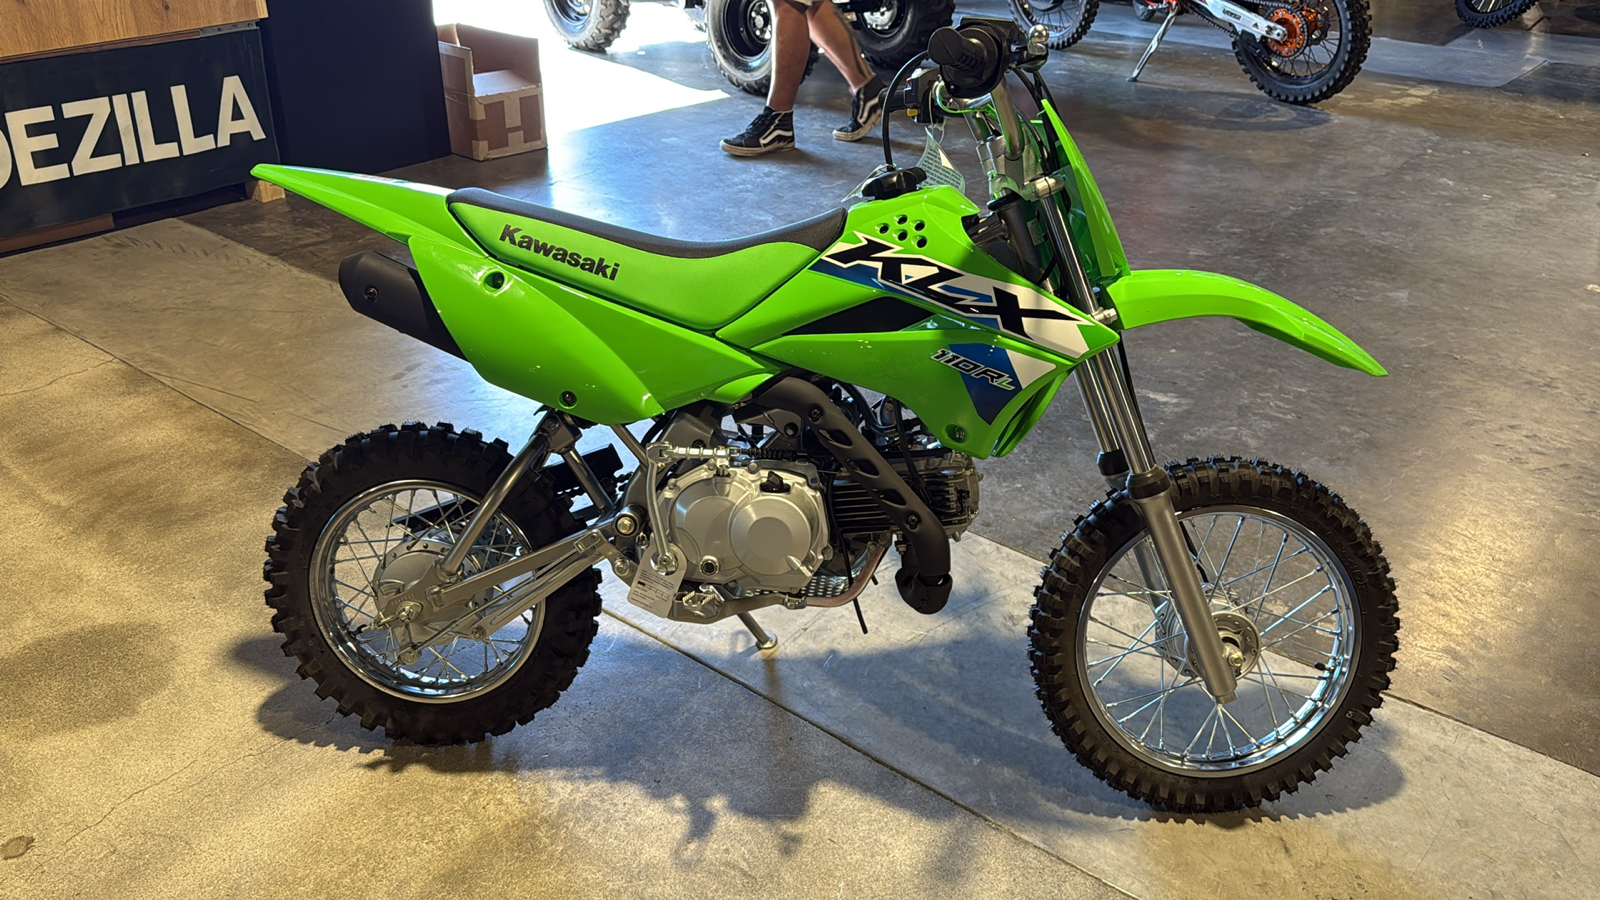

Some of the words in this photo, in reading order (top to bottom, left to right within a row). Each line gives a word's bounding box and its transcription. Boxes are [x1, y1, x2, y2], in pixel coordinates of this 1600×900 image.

[0, 75, 267, 189] EZILLA
[499, 223, 620, 281] Kawasaki
[821, 231, 1086, 342] KLX
[930, 348, 1016, 391] 110RL
